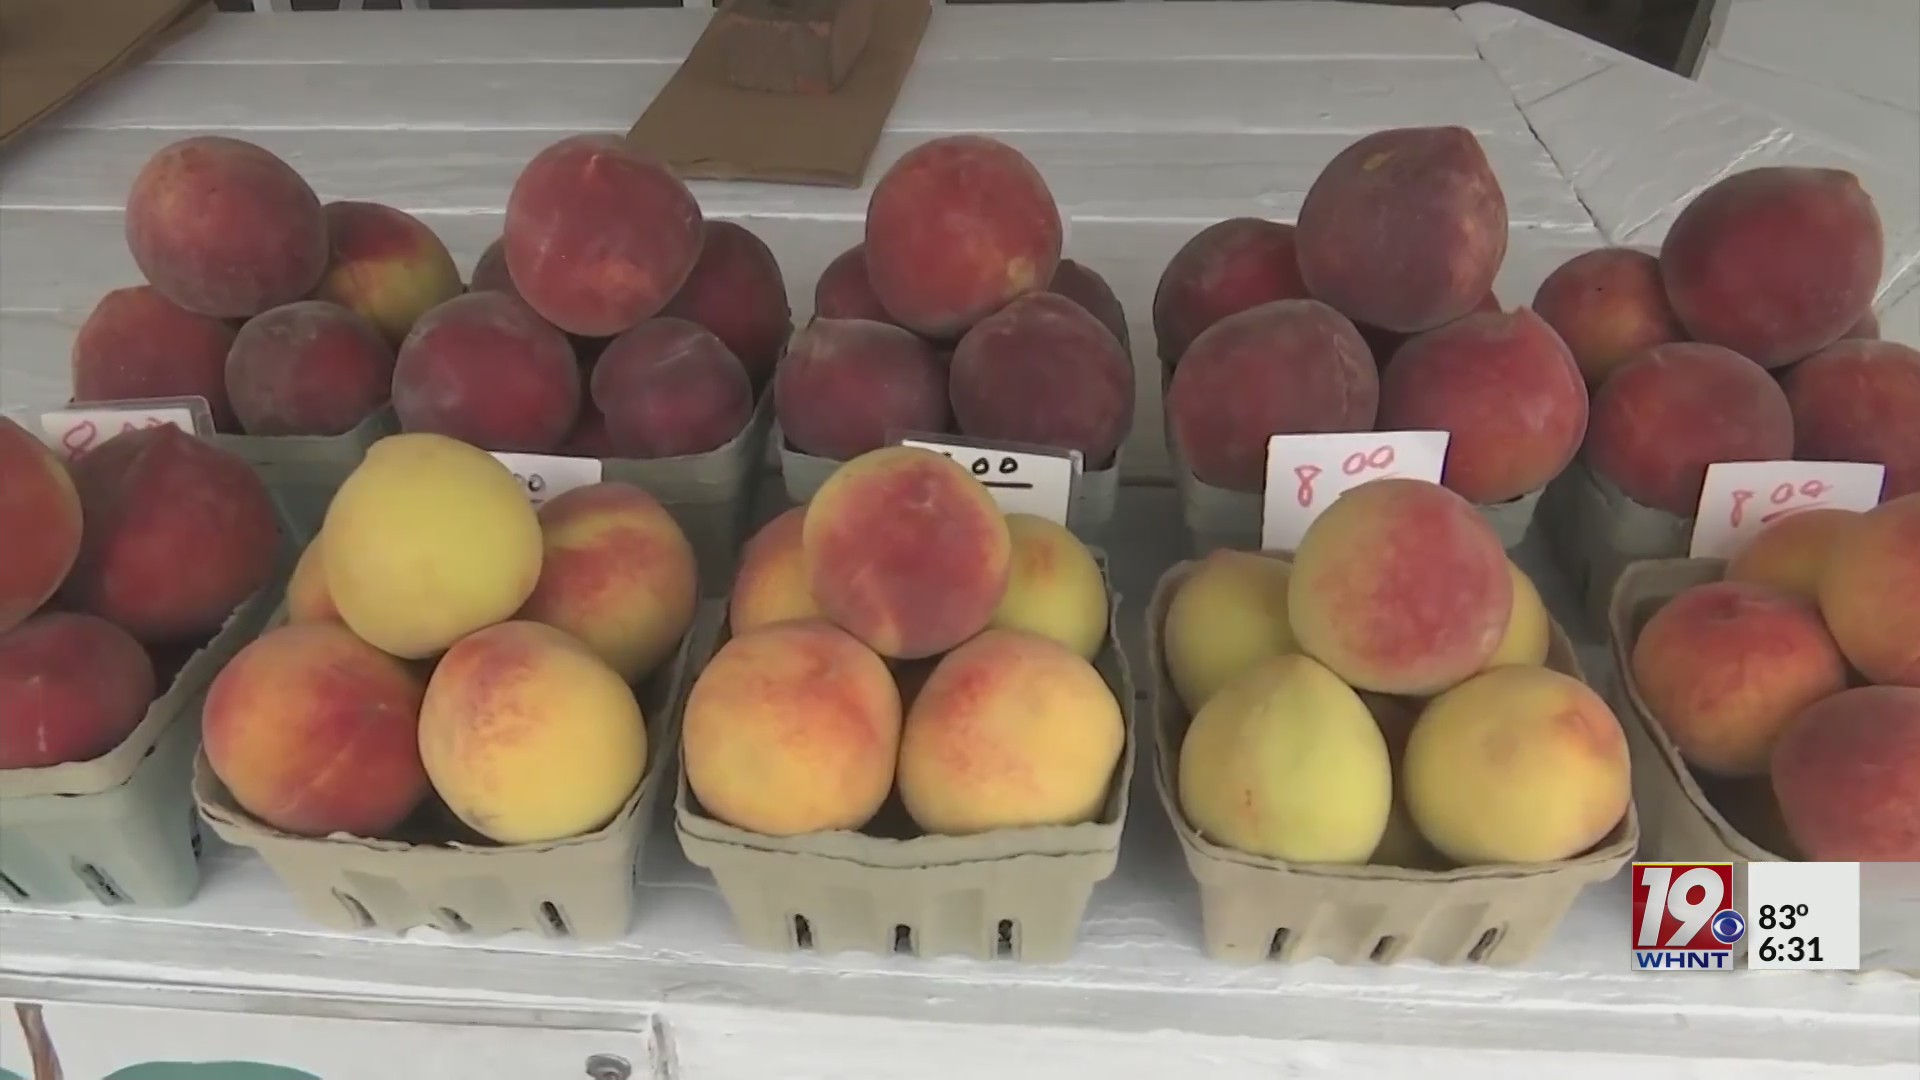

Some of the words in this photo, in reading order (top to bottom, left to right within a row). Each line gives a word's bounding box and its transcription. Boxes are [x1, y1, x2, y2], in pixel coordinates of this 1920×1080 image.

[972, 457, 1018, 475] 00
[1294, 465, 1322, 508] 8
[1342, 445, 1395, 475] 00
